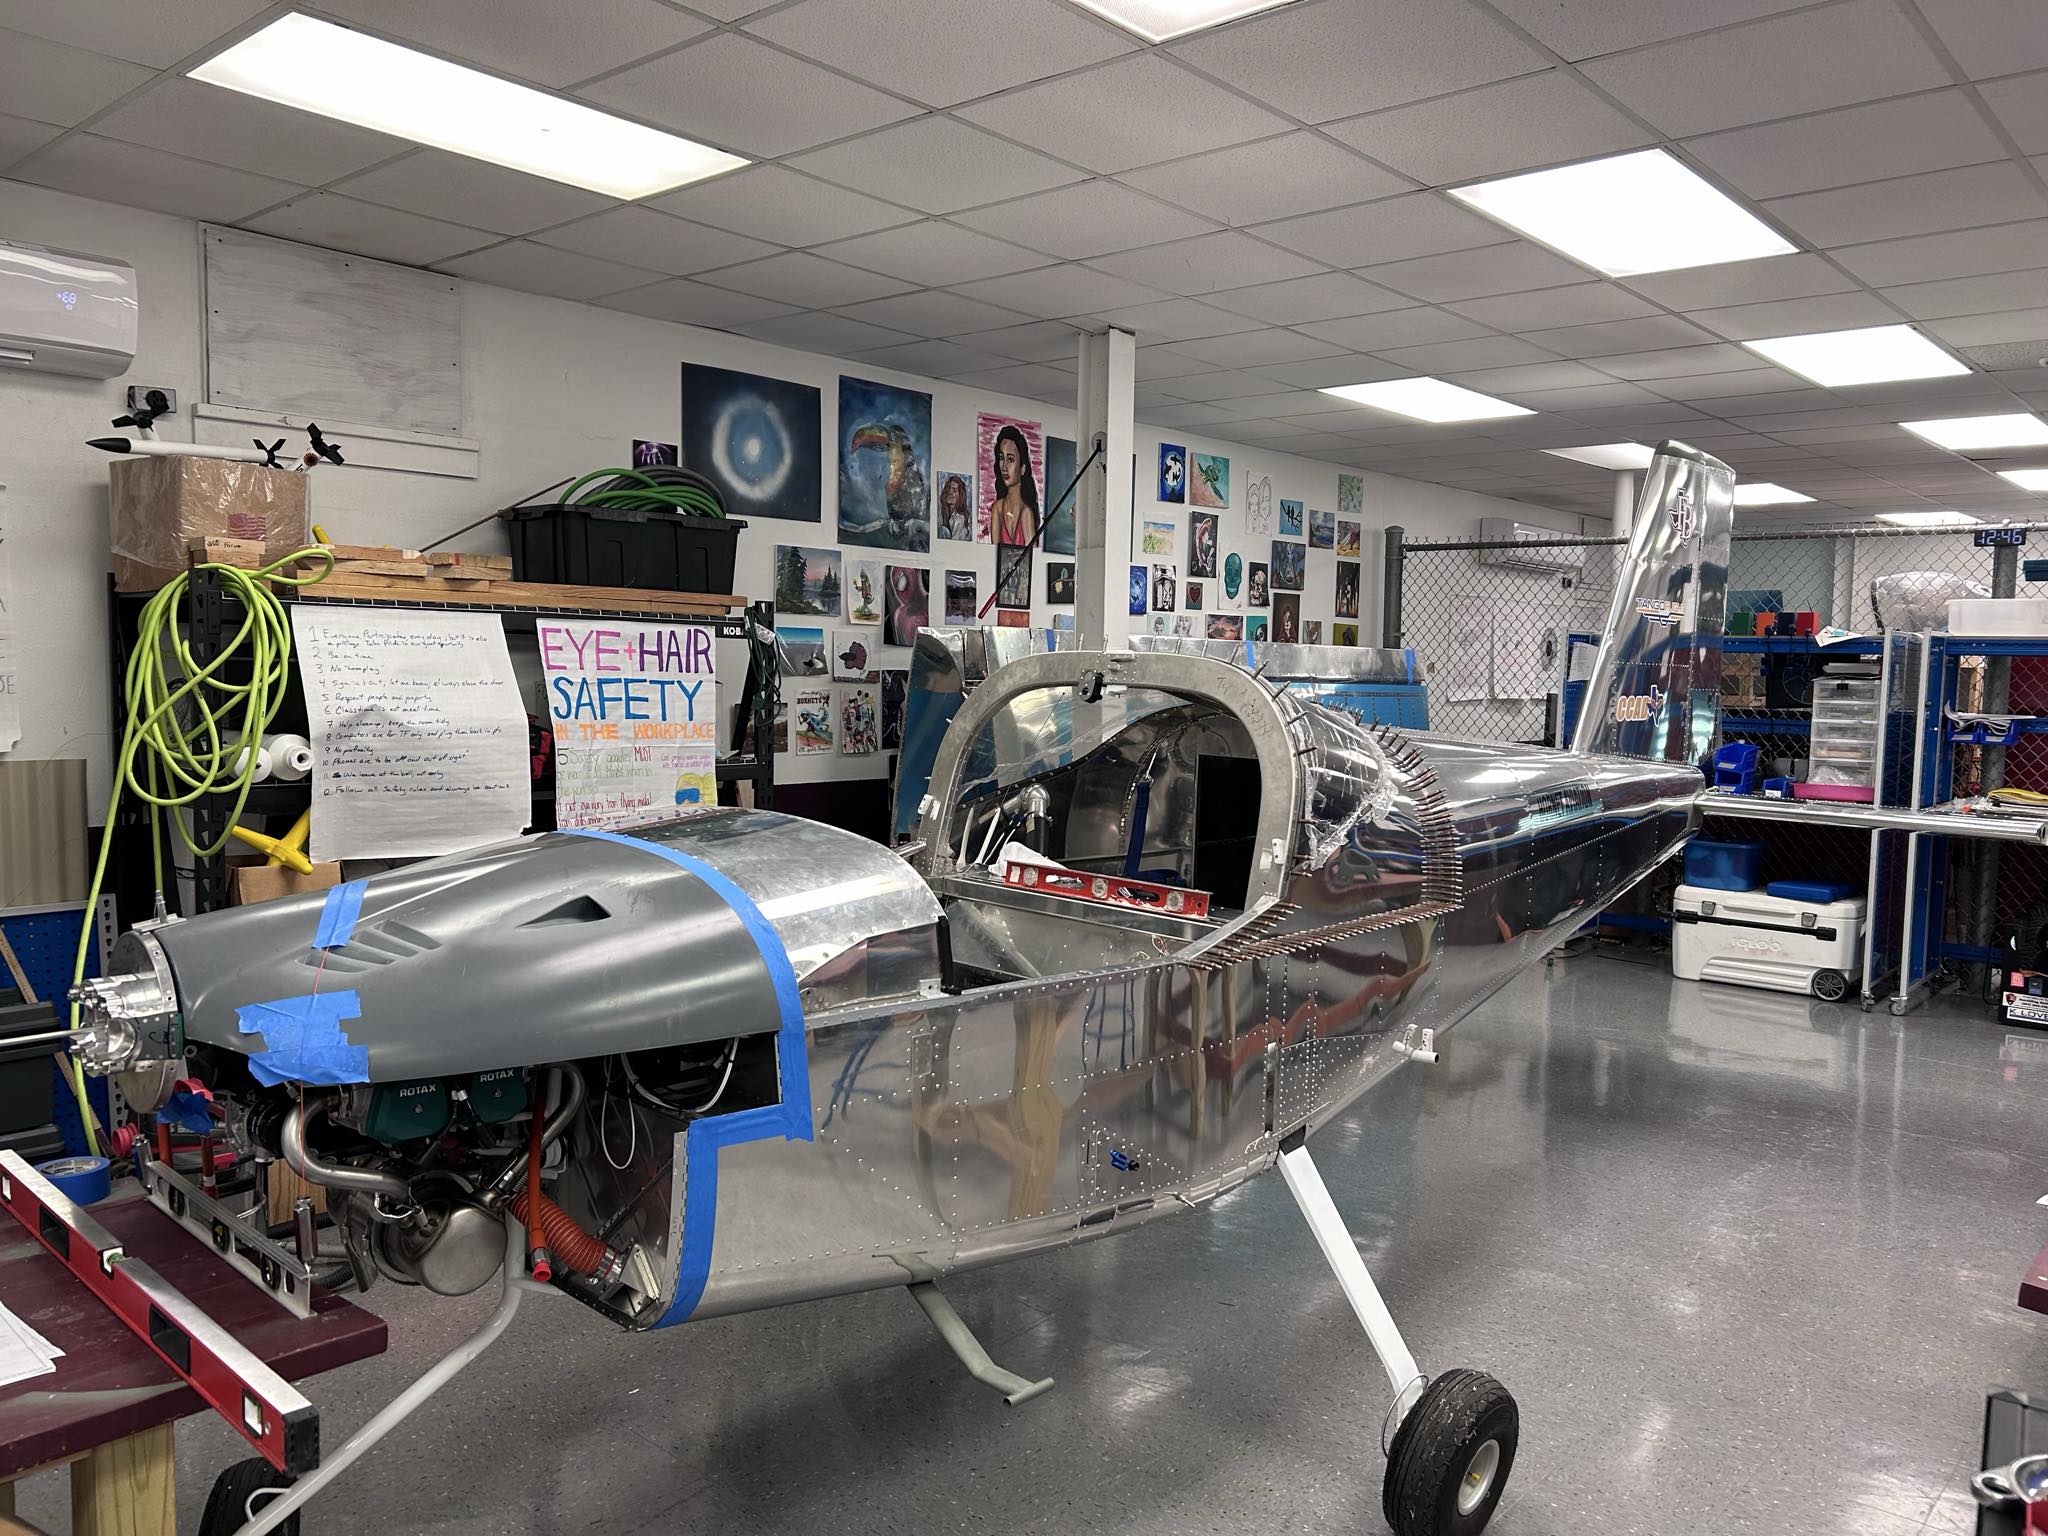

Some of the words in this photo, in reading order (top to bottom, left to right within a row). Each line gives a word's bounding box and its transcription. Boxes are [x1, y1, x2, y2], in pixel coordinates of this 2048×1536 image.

[62, 291, 77, 304] 68
[1979, 529, 2023, 544] 12:46
[331, 665, 341, 673] No
[552, 677, 703, 722] SAFETY
[579, 723, 620, 740] THE
[633, 722, 714, 740] WORKPLACE
[634, 746, 652, 762] MUST
[480, 1069, 515, 1083] ROTAX
[400, 1084, 437, 1098] ROTAX
